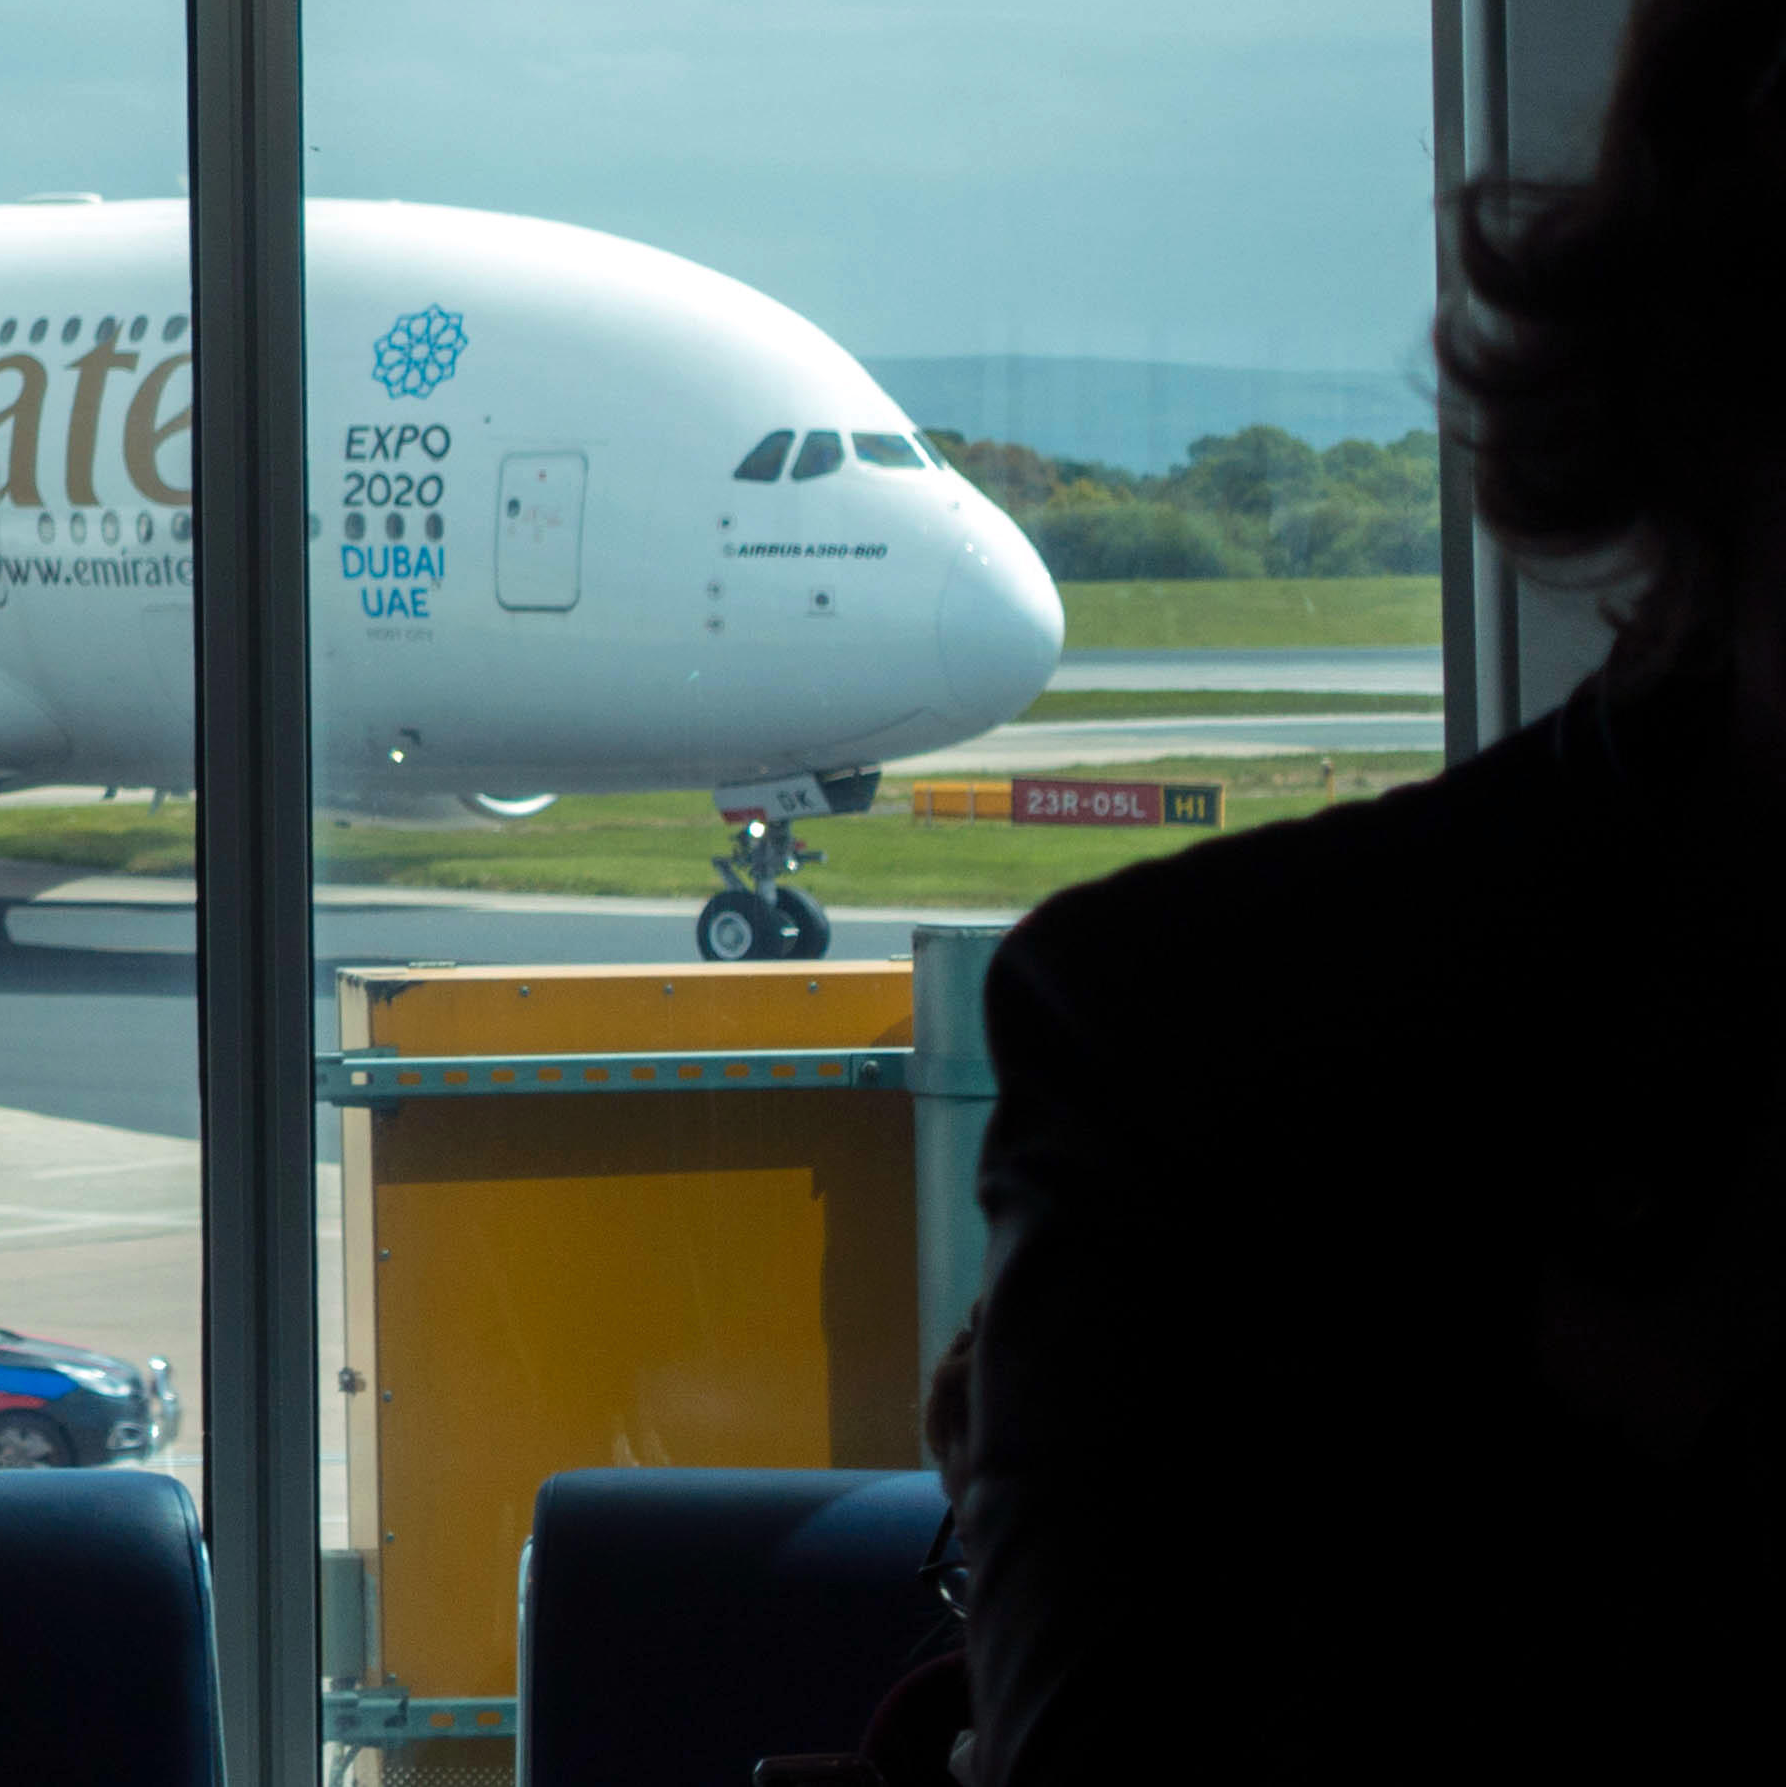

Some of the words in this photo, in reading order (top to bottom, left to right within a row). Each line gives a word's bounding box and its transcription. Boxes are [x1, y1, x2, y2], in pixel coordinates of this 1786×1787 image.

[344, 423, 451, 462] EXPO
[343, 471, 444, 508] 2020
[340, 545, 445, 580] DUBAI
[361, 587, 430, 619] UAE
[1027, 789, 1145, 819] 23R-05L
